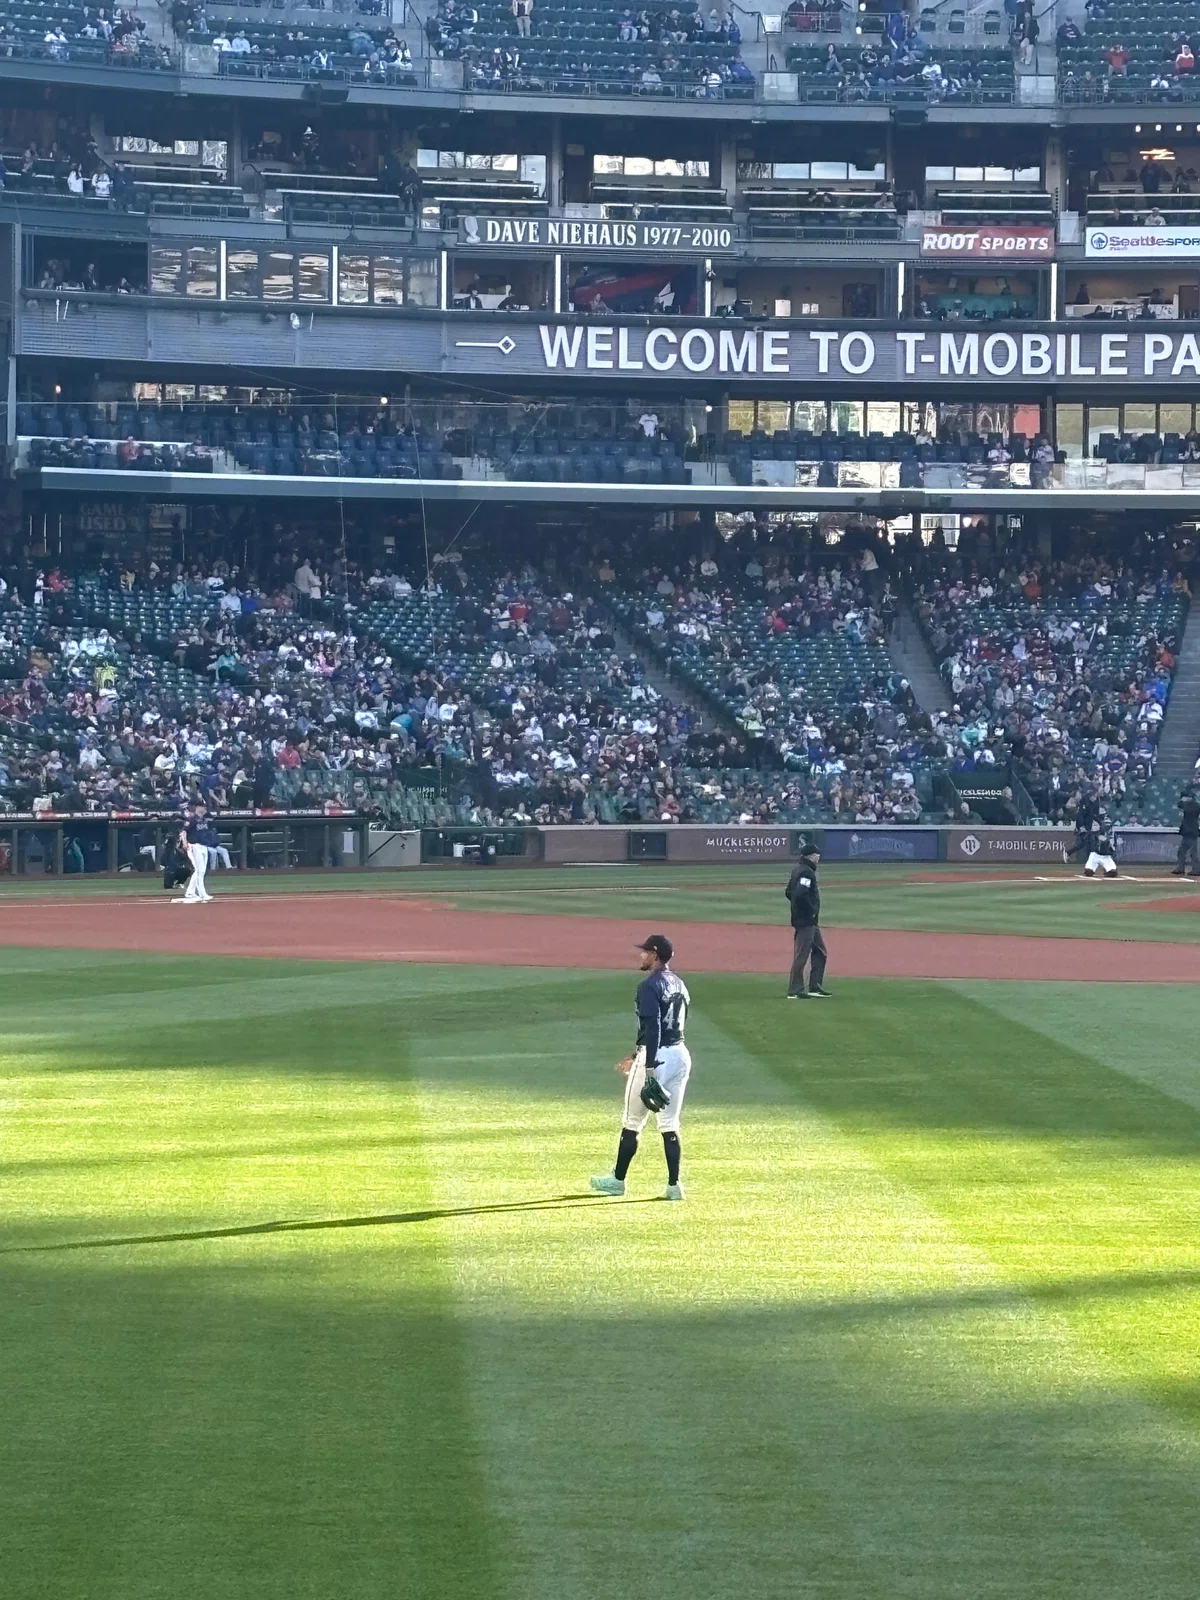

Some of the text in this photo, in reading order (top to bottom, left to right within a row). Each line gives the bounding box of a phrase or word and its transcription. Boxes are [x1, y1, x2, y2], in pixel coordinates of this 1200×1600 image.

[486, 220, 731, 248] DAVE NIEHAUS 1977-2010
[923, 233, 1049, 251] ROOT SPORTS
[539, 324, 790, 374] WELCOME
[809, 331, 875, 375] TO
[896, 332, 1129, 376] T-MOBILE
[80, 516, 126, 530] USED
[706, 837, 787, 847] MUCKLESHOOT
[988, 840, 1036, 851] T-MOBILE
